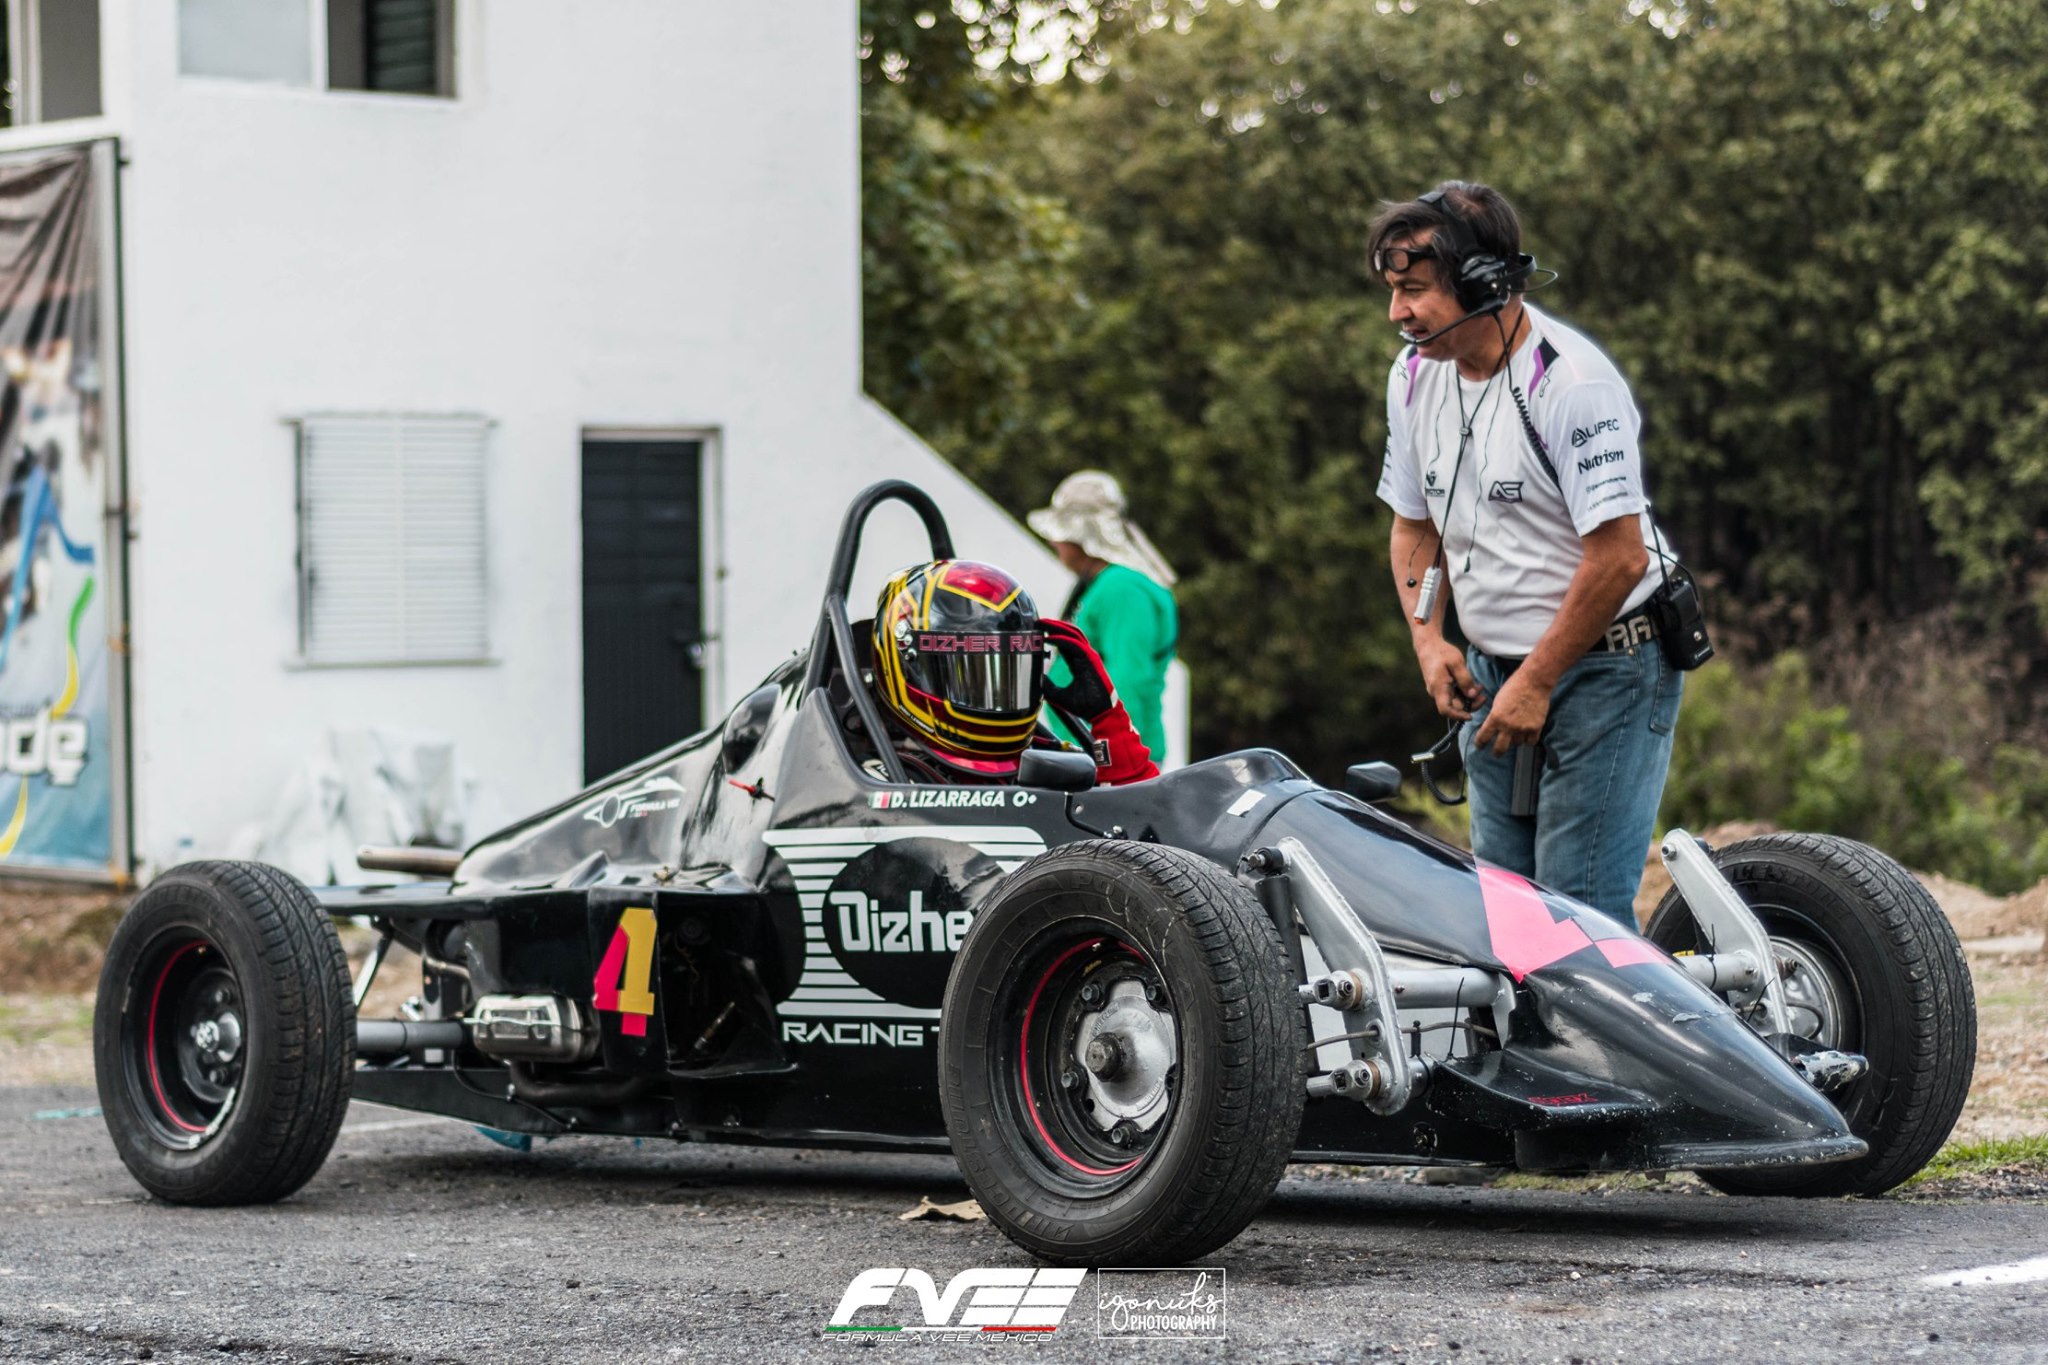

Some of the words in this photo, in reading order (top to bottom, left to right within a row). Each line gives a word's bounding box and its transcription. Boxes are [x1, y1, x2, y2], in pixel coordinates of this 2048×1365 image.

[1578, 449, 1625, 474] Nutrism
[919, 634, 1001, 652] DIZHER
[0, 703, 88, 786] de
[782, 1021, 924, 1047] RACING
